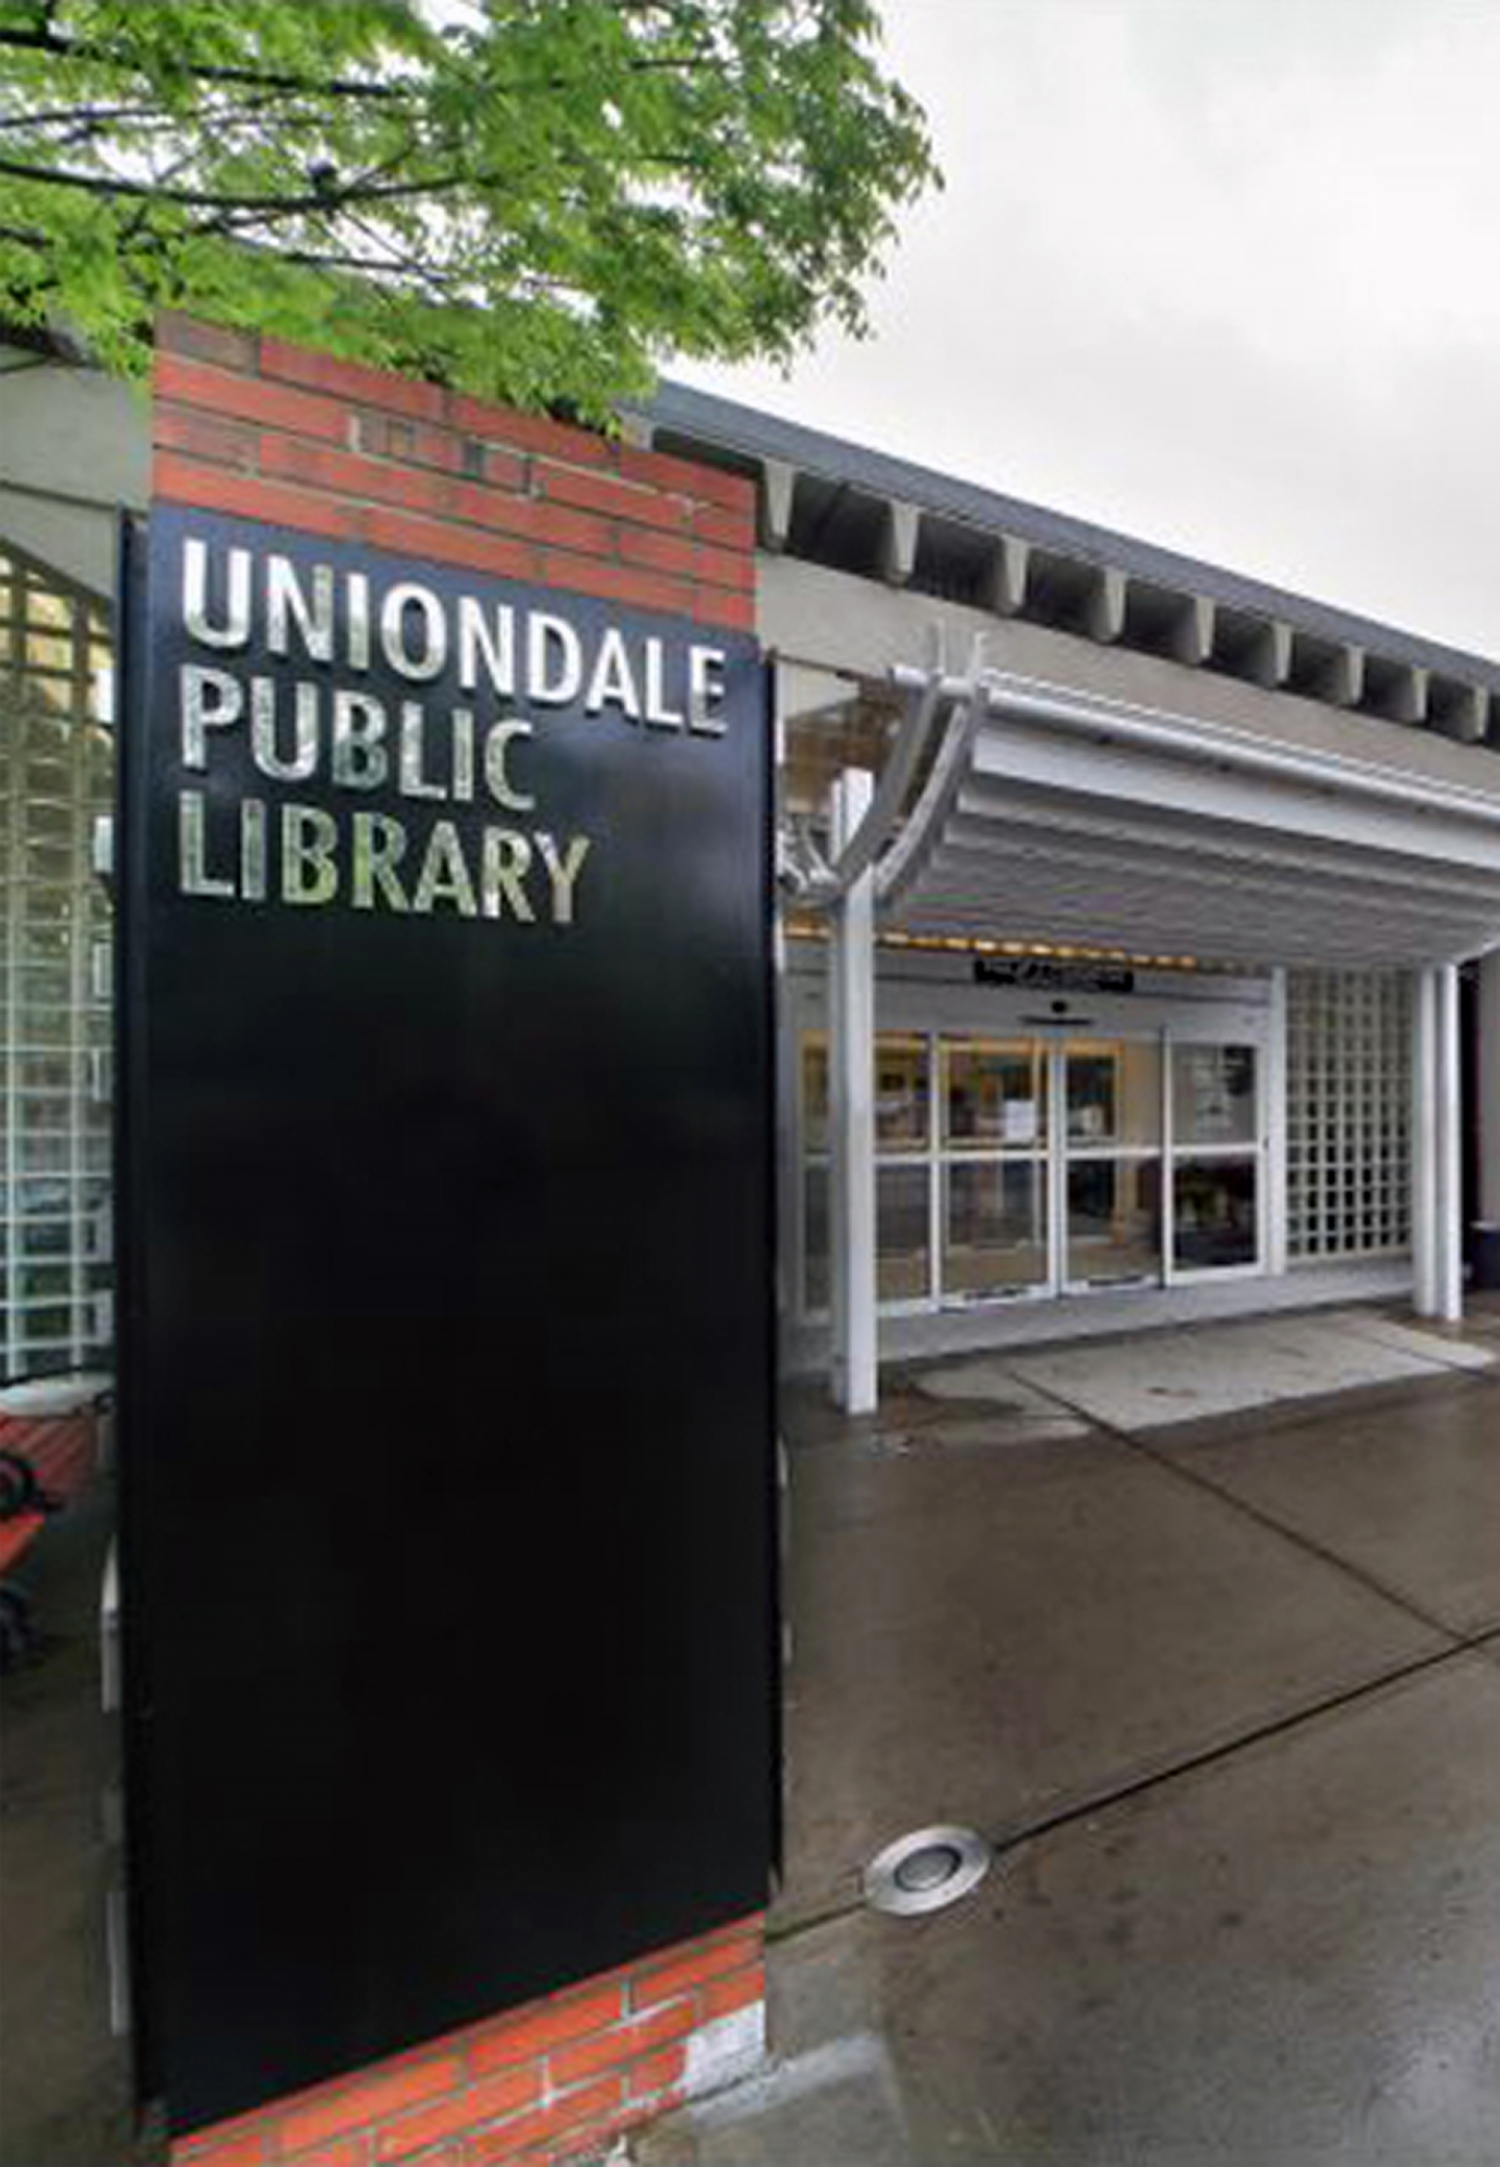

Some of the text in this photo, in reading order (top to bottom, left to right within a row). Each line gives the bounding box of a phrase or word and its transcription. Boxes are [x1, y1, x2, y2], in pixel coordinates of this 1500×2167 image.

[182, 538, 729, 733] UNIONDALE
[180, 664, 536, 810] PUBLIC
[180, 790, 590, 923] LIBRARY
